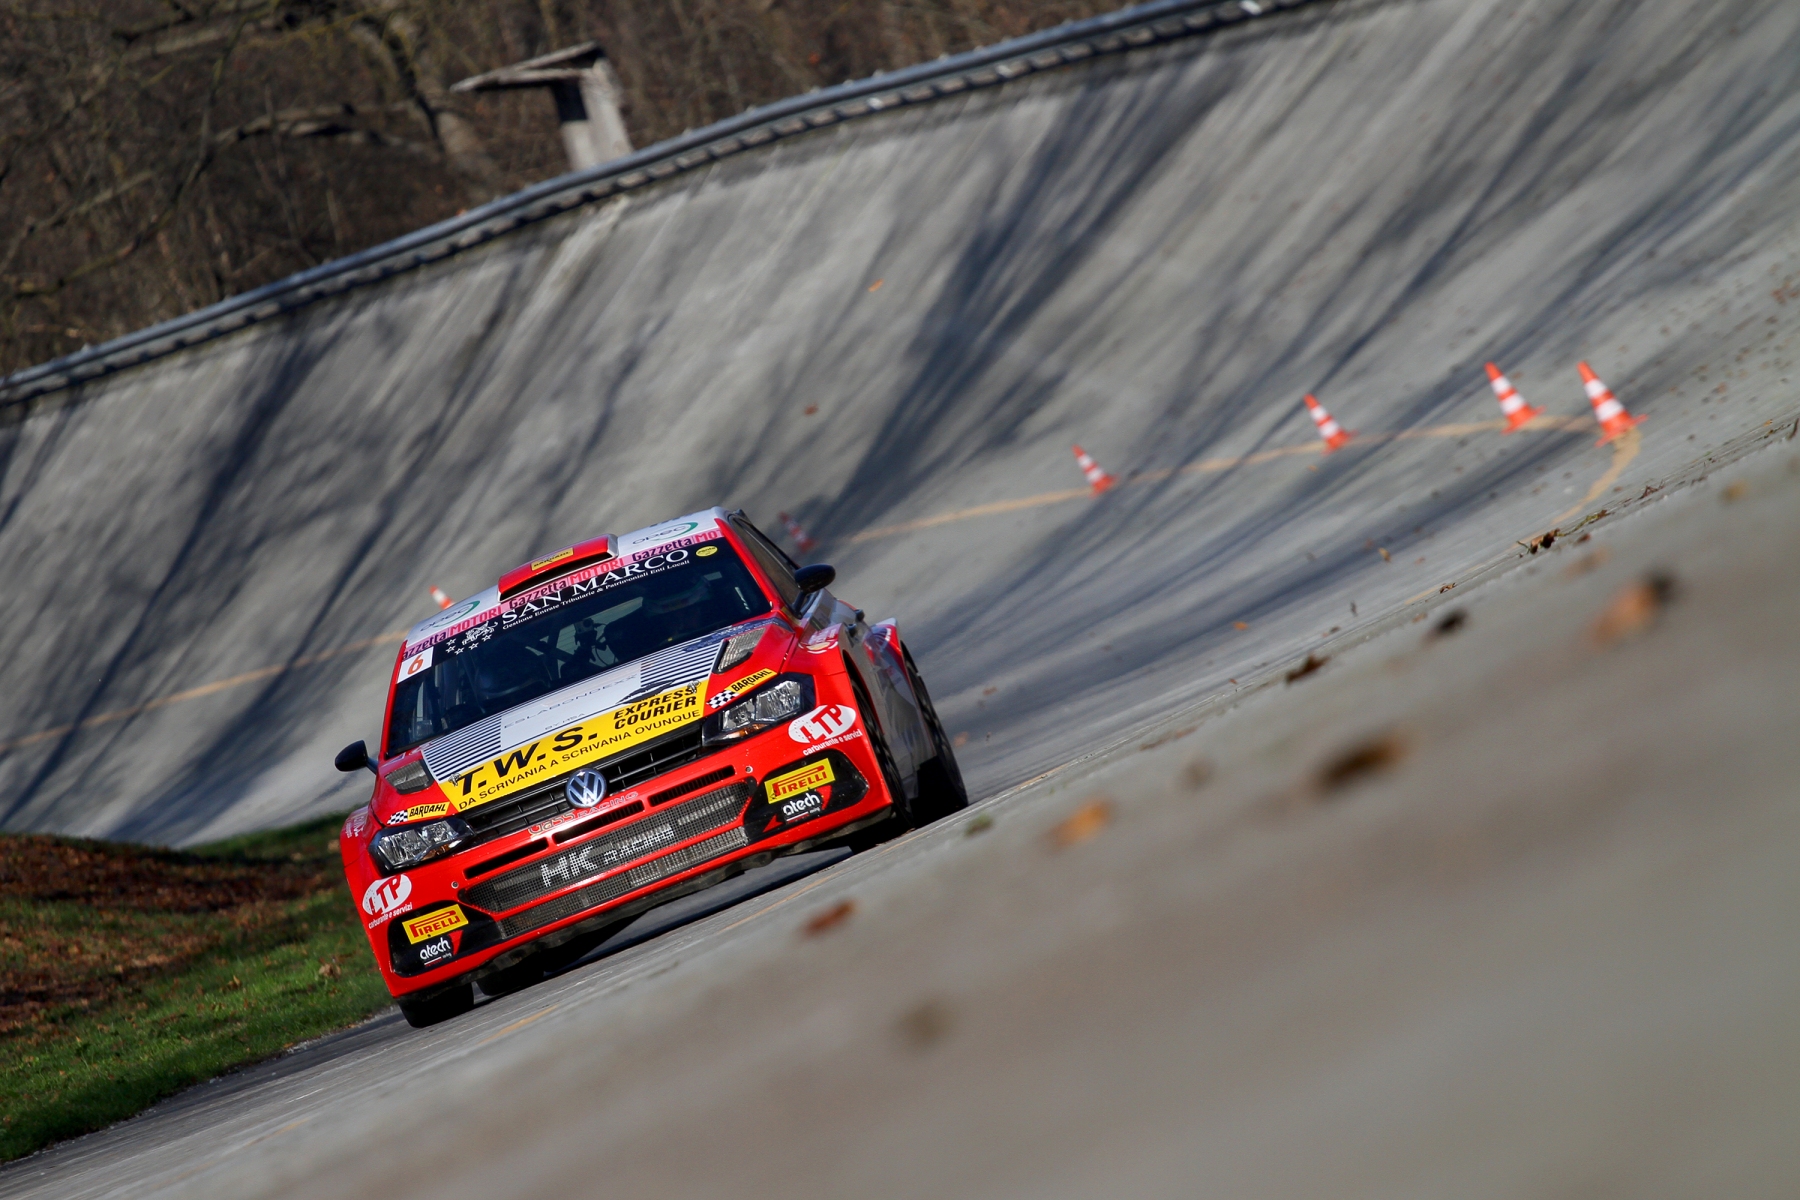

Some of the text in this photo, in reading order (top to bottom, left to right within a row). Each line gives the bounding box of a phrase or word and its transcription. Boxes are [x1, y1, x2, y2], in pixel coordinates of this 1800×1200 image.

[403, 631, 447, 659] azzetta
[449, 606, 501, 636] MOTORI
[509, 579, 567, 609] Gazzetta
[569, 558, 624, 585] MOTORI
[632, 538, 692, 562] Gazzetta
[502, 549, 688, 624] SAN MARCO
[502, 614, 533, 630] Gestione
[534, 604, 560, 617] Entrate
[560, 590, 595, 606] Tributarie
[605, 571, 648, 590] Patrimoniali
[650, 566, 665, 575] Enti
[667, 559, 690, 570] Locali
[407, 653, 424, 675] 6
[731, 670, 773, 692] BARDAHL
[614, 686, 697, 720] EXPRESS
[614, 696, 697, 730] COURIER
[800, 704, 843, 743] LTP
[802, 737, 839, 756] carburante
[844, 728, 863, 741] servizi
[458, 709, 701, 810] DA SCRIVANIA A SCRIVANIA OVUNQUE
[772, 765, 827, 797] PIRELLI
[409, 803, 446, 817] BARDAHL
[783, 792, 820, 815] atech
[540, 845, 597, 888] HK
[368, 874, 402, 914] LTP
[393, 902, 413, 917] servizi
[409, 910, 461, 939] PIRELLI
[420, 937, 451, 960] atech
